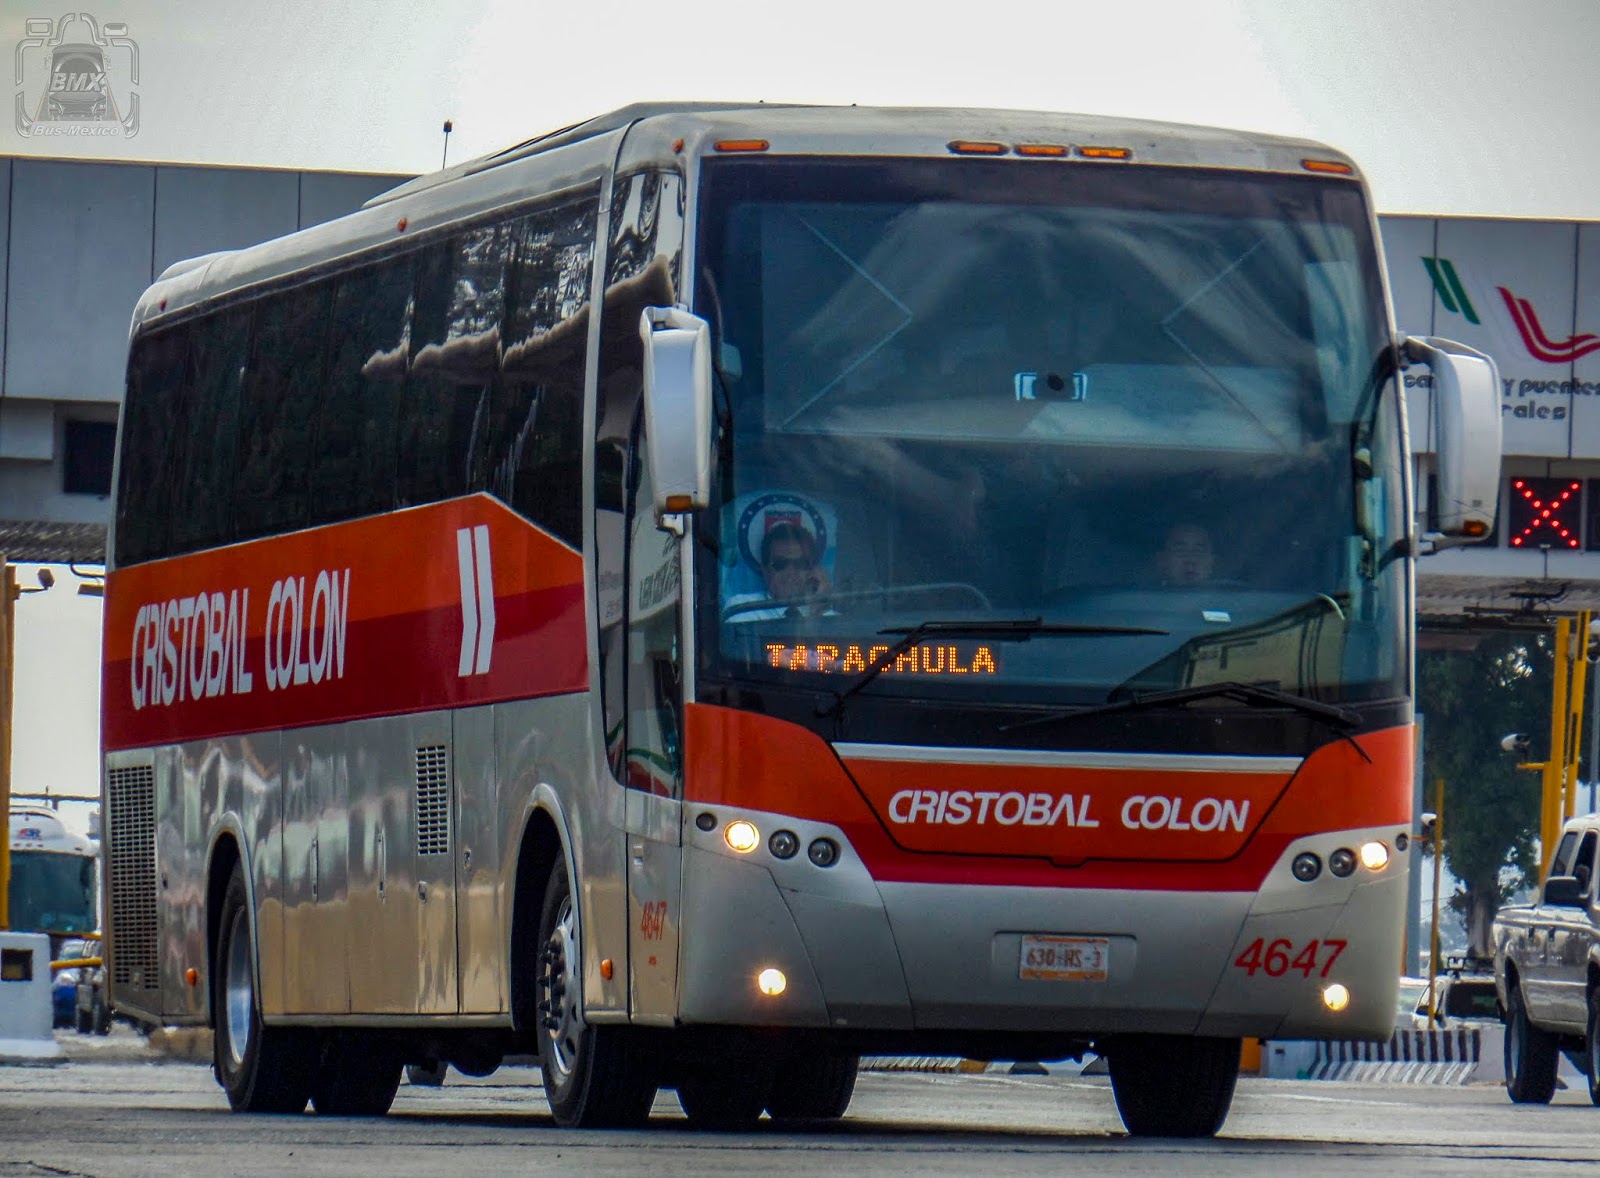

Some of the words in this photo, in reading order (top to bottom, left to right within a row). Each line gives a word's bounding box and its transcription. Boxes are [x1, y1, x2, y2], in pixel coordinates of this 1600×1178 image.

[131, 587, 253, 711] CRISTOBAL
[264, 567, 350, 692] COLON
[888, 789, 1100, 828] CRISTOBAL
[1120, 794, 1251, 832] COLON
[641, 901, 668, 941] 4647
[1234, 937, 1348, 978] 4647
